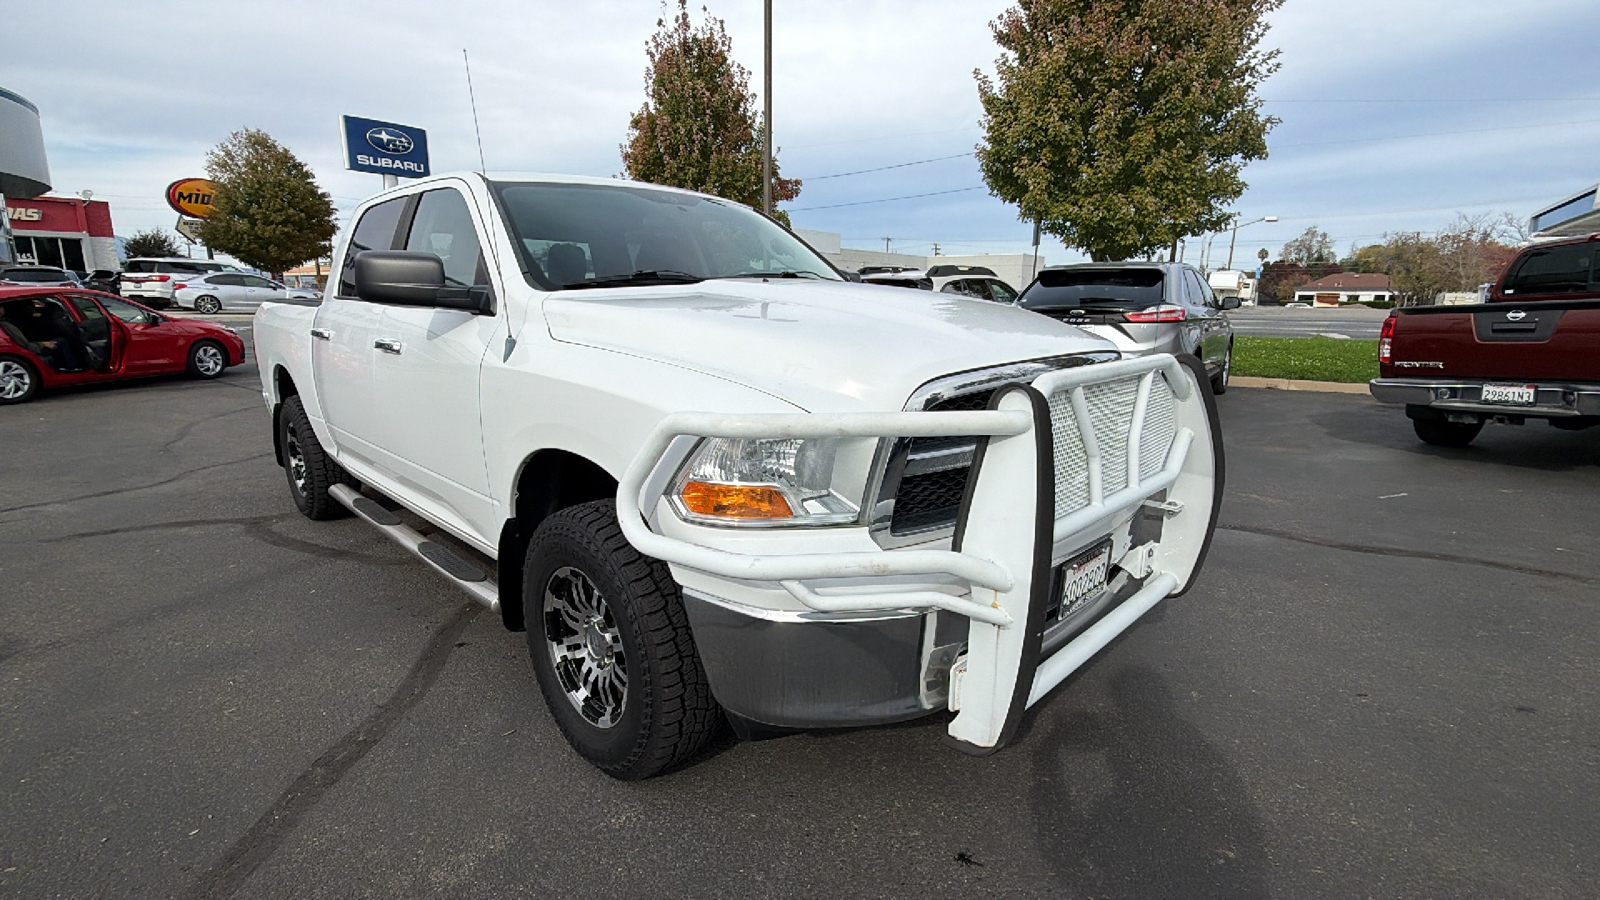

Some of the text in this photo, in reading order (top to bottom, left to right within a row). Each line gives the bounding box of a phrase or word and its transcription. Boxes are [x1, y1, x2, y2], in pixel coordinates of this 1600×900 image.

[356, 154, 424, 173] SUBARU
[177, 191, 212, 206] MID
[1394, 361, 1444, 369] FRONTIER
[1484, 390, 1532, 402] 29861N3
